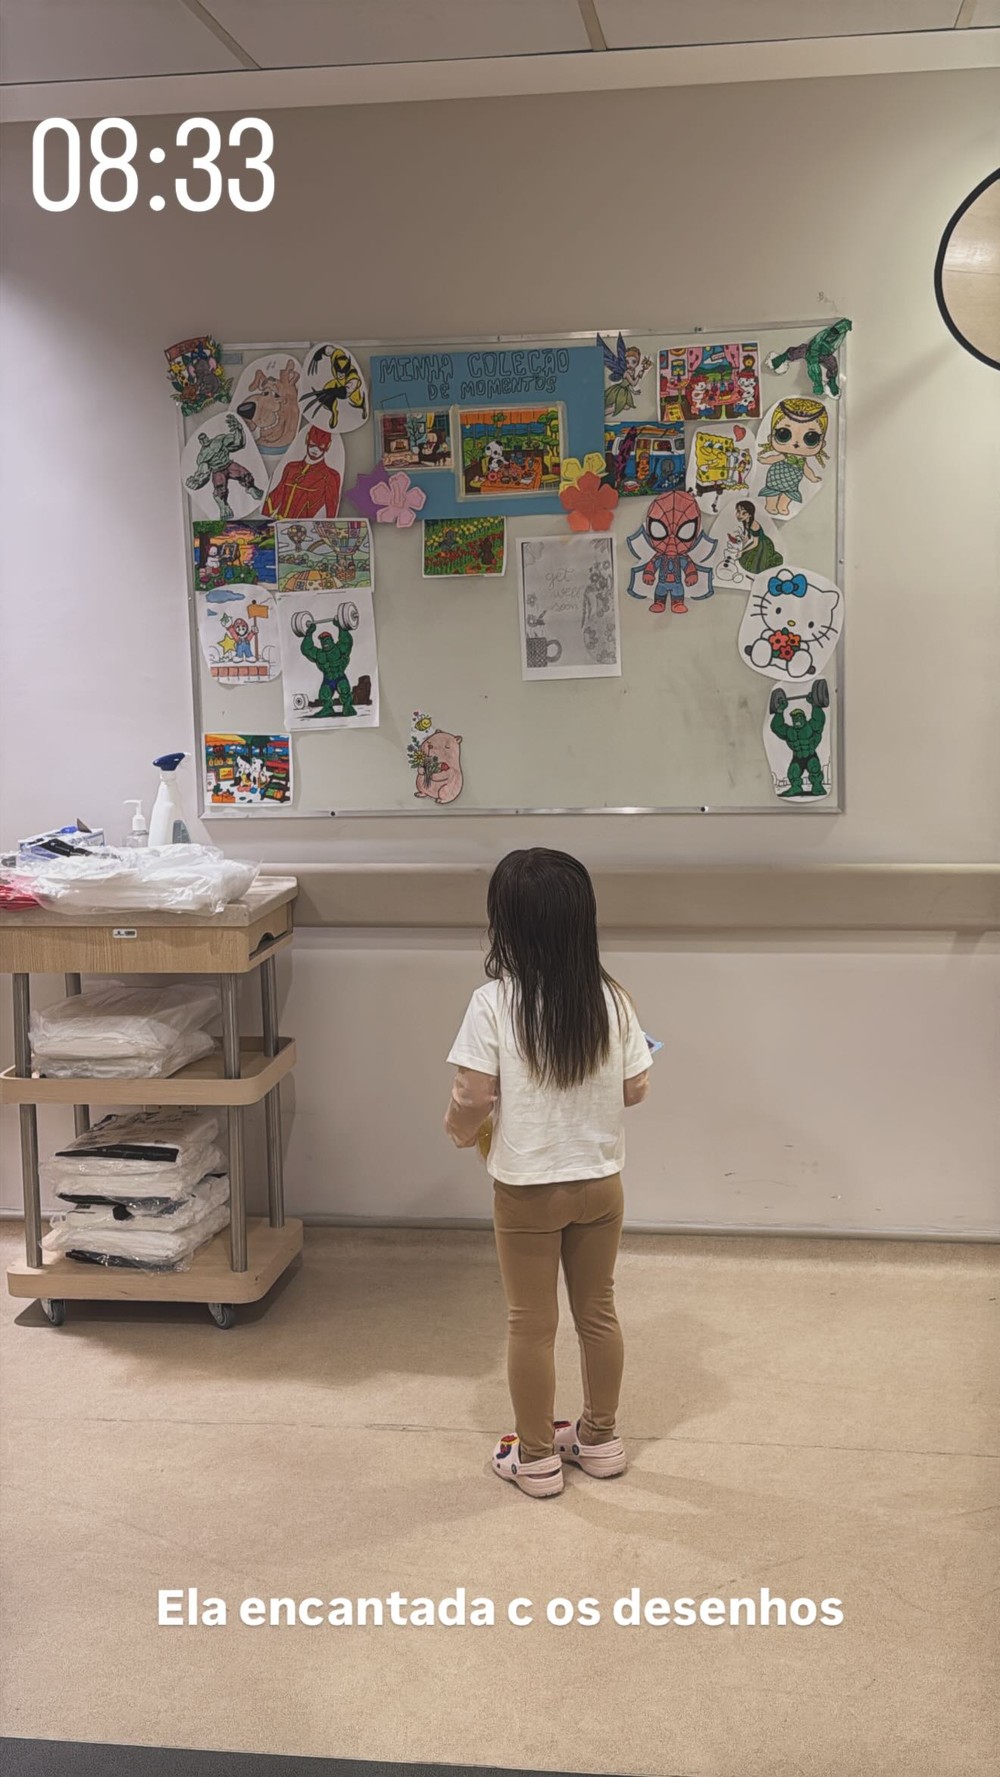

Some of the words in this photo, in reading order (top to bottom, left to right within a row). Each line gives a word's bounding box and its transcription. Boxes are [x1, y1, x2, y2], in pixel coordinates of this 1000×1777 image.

[379, 353, 454, 383] MINHA
[427, 383, 450, 400] DE
[461, 376, 557, 399] MOMENTOS
[545, 568, 574, 590] get
